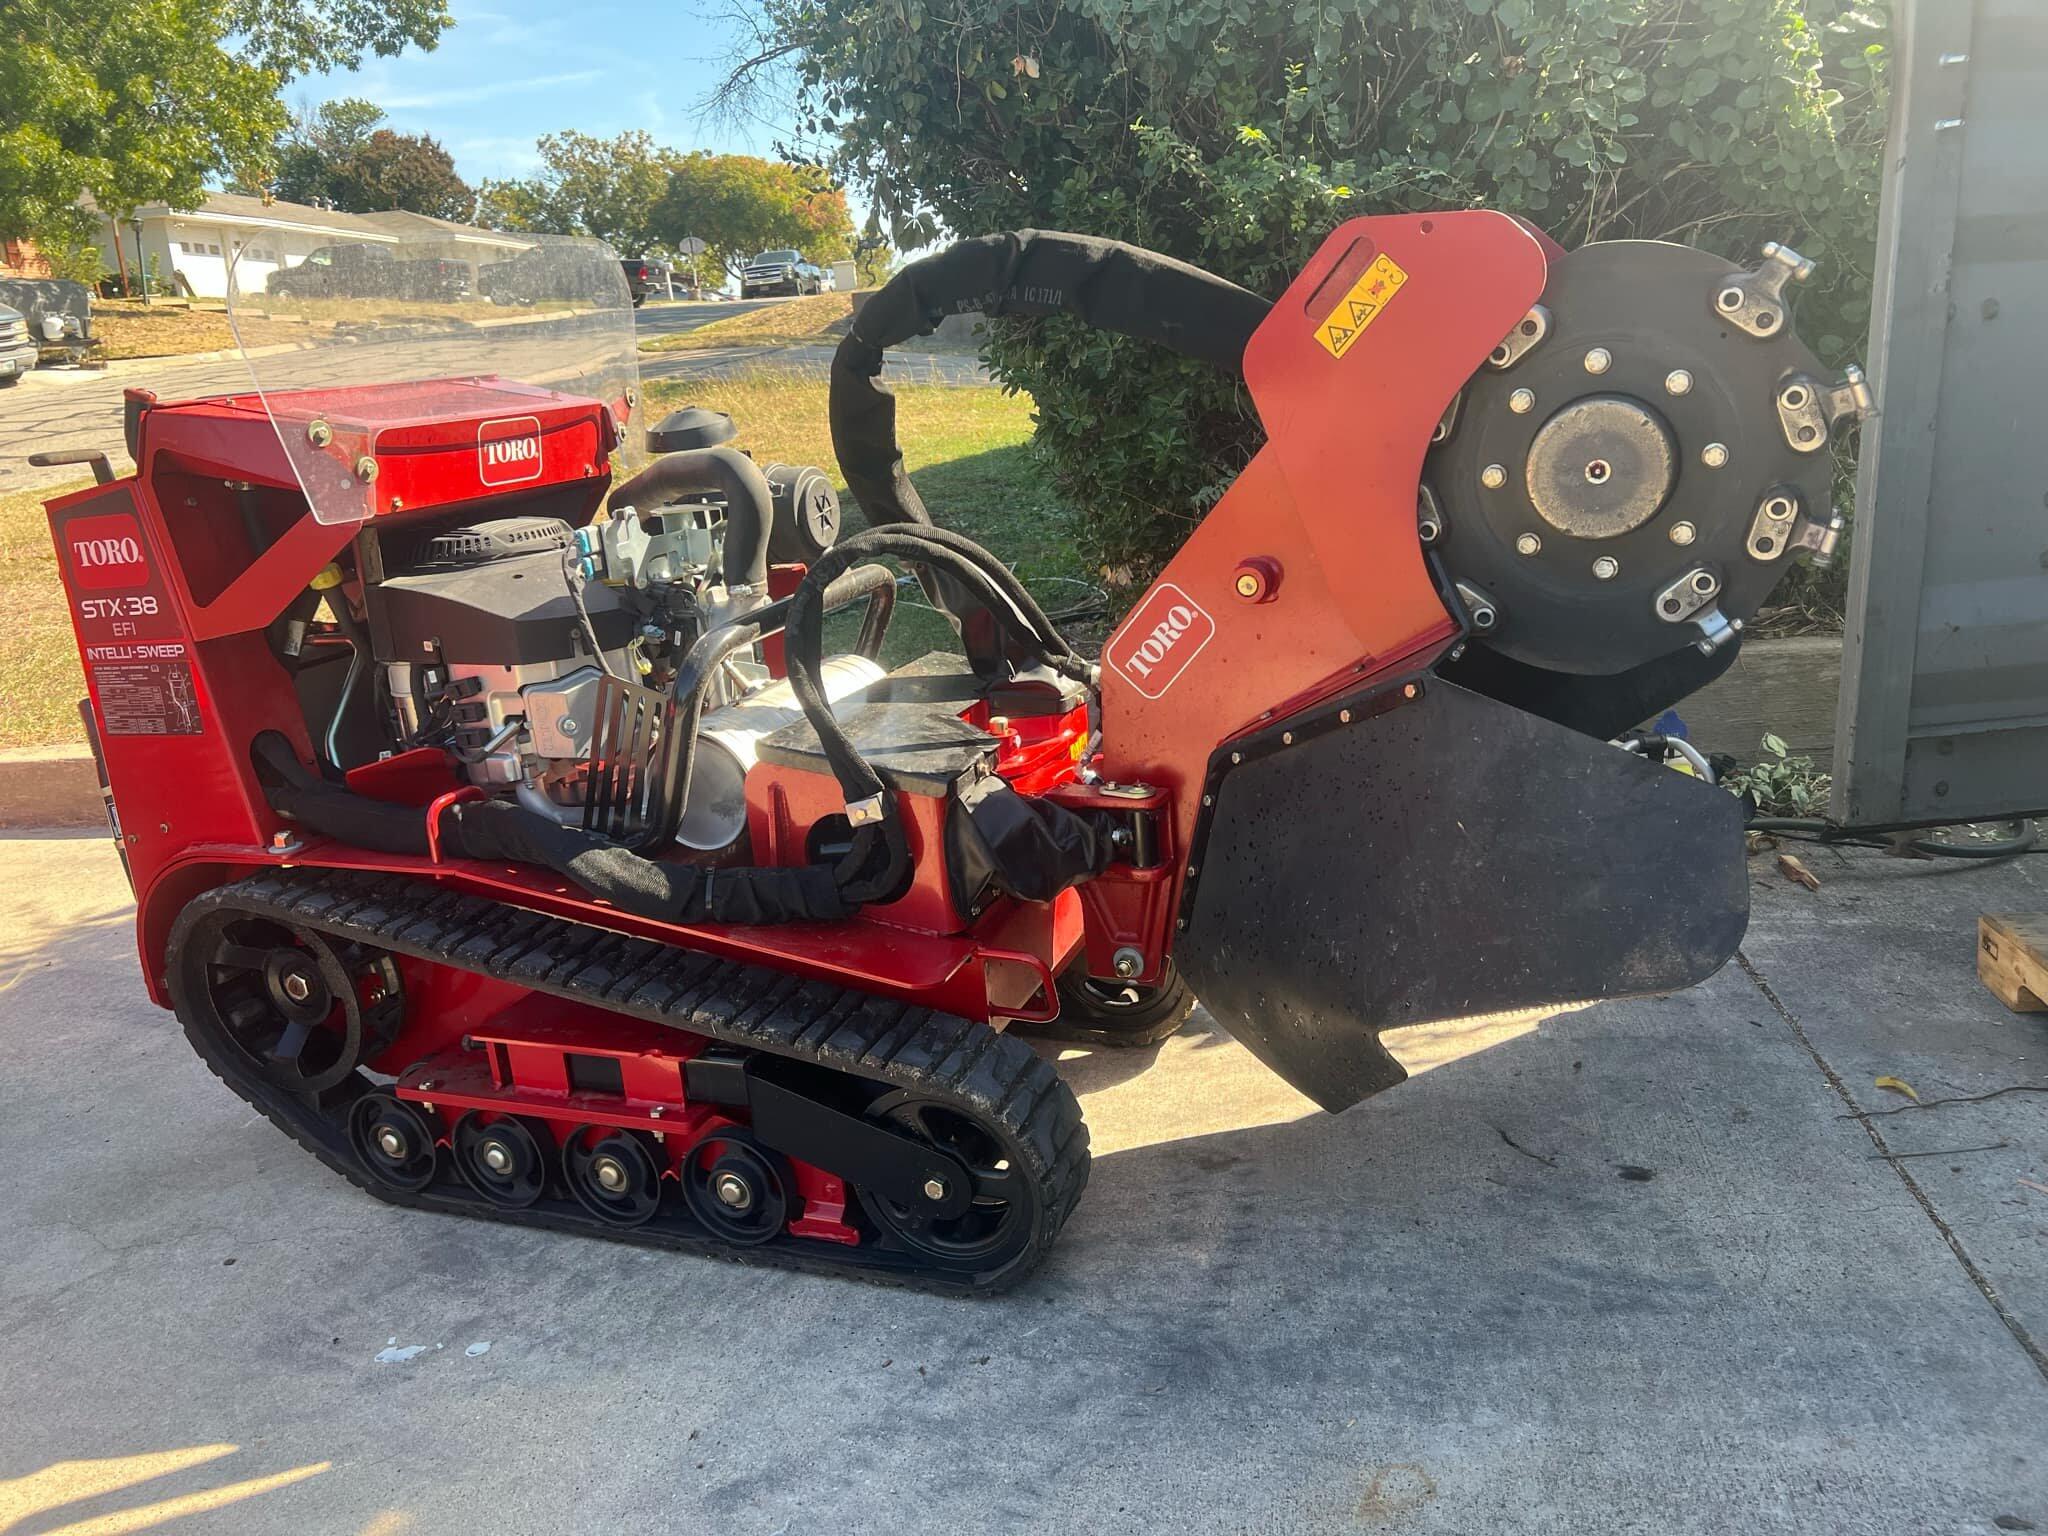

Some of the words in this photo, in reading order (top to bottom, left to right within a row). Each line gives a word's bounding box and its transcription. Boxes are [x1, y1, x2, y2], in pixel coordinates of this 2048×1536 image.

[484, 437, 537, 465] TORO
[73, 537, 139, 567] TORO
[112, 621, 137, 637] EFI
[1124, 605, 1192, 679] TORO
[86, 644, 185, 660] INTELLI-SWEEP
